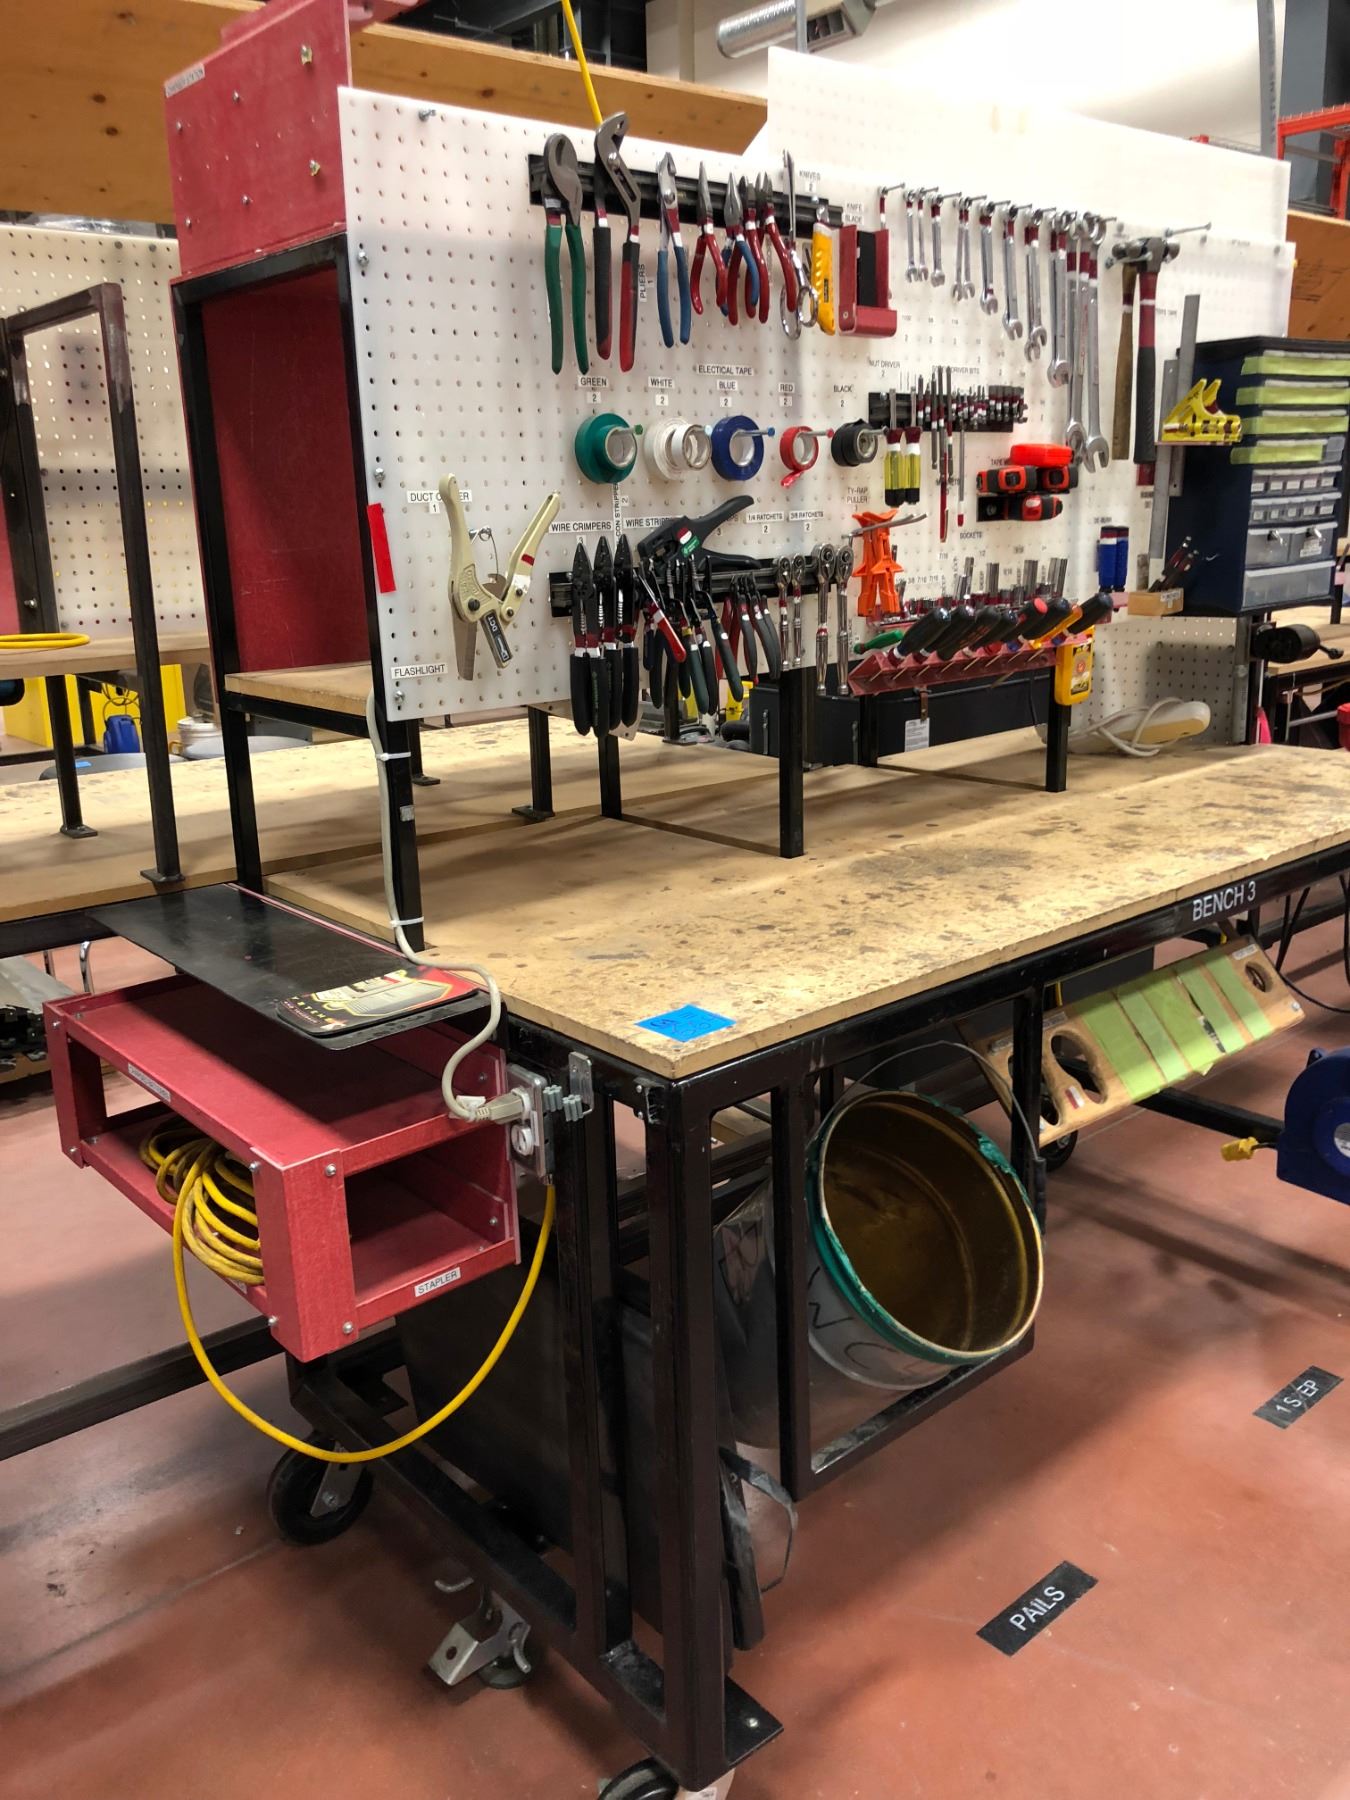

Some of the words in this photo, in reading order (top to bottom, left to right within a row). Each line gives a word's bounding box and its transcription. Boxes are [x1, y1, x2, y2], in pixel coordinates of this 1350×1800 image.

[698, 365, 734, 375] ELECTICAL
[735, 367, 753, 376] TAPE
[580, 377, 607, 387] GREEN
[650, 378, 673, 388] WHITE
[718, 381, 736, 390] BLUE
[779, 383, 794, 392] RED
[833, 384, 852, 393] BLACK
[592, 393, 597, 402] 2
[660, 396, 665, 405] 2
[723, 398, 729, 407] 2
[410, 492, 434, 502] DUCT
[433, 503, 437, 513] 1
[756, 513, 783, 521] RATCHETS
[551, 523, 571, 532] WIRE
[572, 521, 612, 531] CRIMPERS
[625, 518, 644, 528] WIRE
[805, 523, 810, 531] 2
[763, 525, 769, 534] 2
[394, 663, 446, 678] FLASHLIGHT
[1192, 884, 1245, 921] BENCH
[1247, 880, 1257, 902] 3
[418, 1270, 458, 1294] STAPLER
[1009, 1586, 1066, 1632] PAILS
